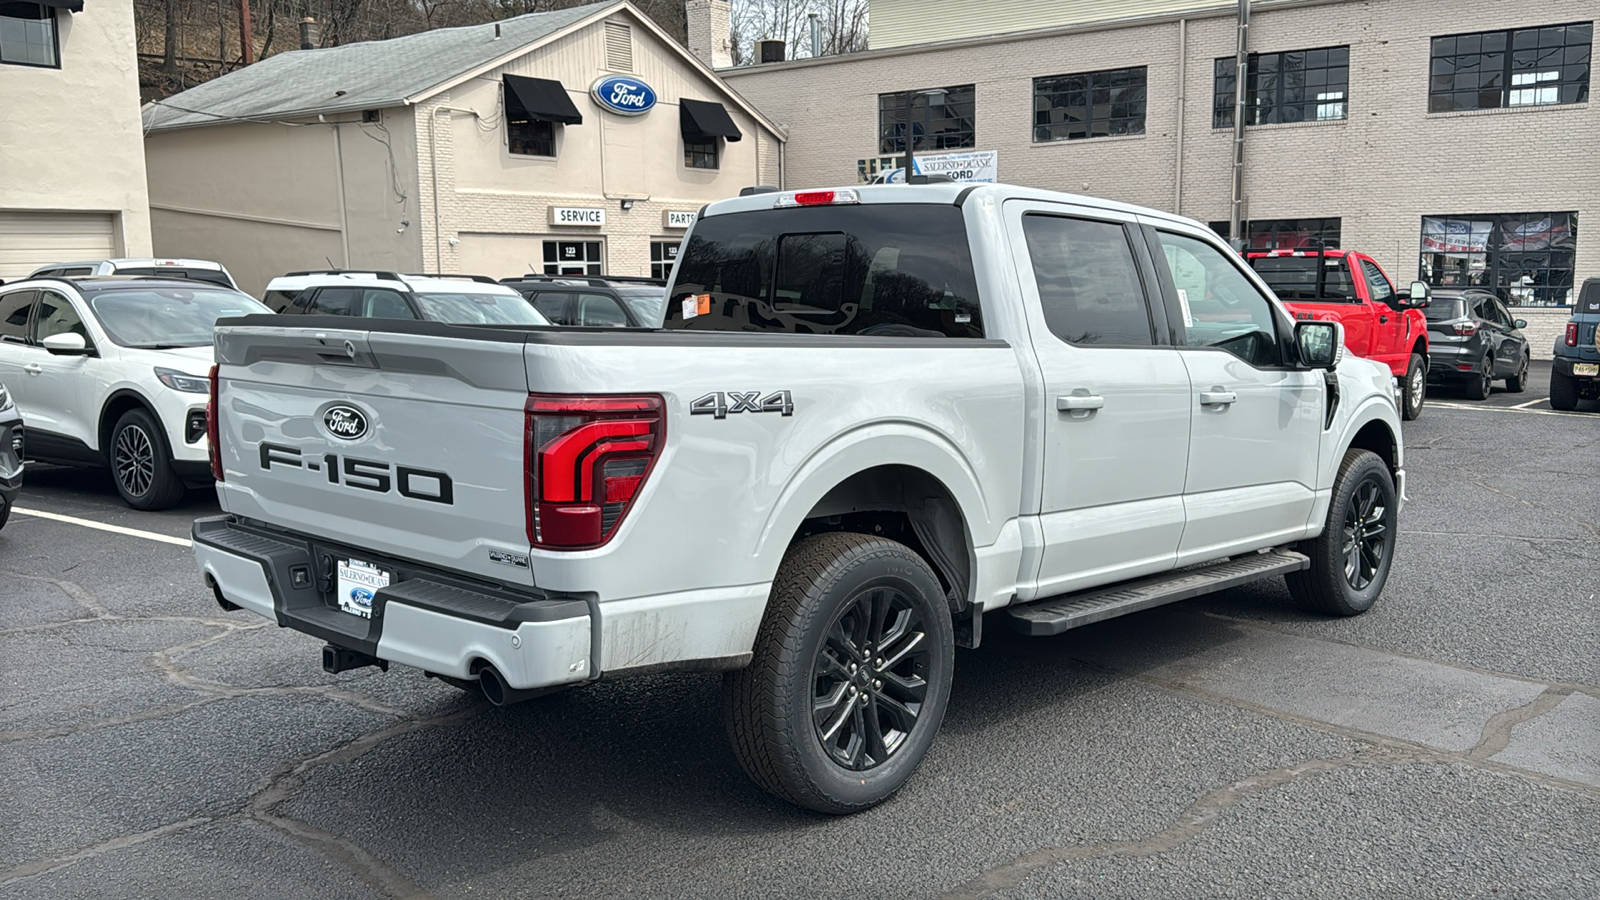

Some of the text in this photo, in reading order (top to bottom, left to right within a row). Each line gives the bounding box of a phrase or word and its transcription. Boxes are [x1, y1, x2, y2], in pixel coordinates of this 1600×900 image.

[610, 82, 646, 107] Ford
[924, 158, 991, 172] SALERNO DUANE
[561, 210, 600, 222] SERVICE
[329, 410, 358, 434] Ford
[259, 442, 453, 505] F-150
[340, 568, 365, 582] SALERNO
